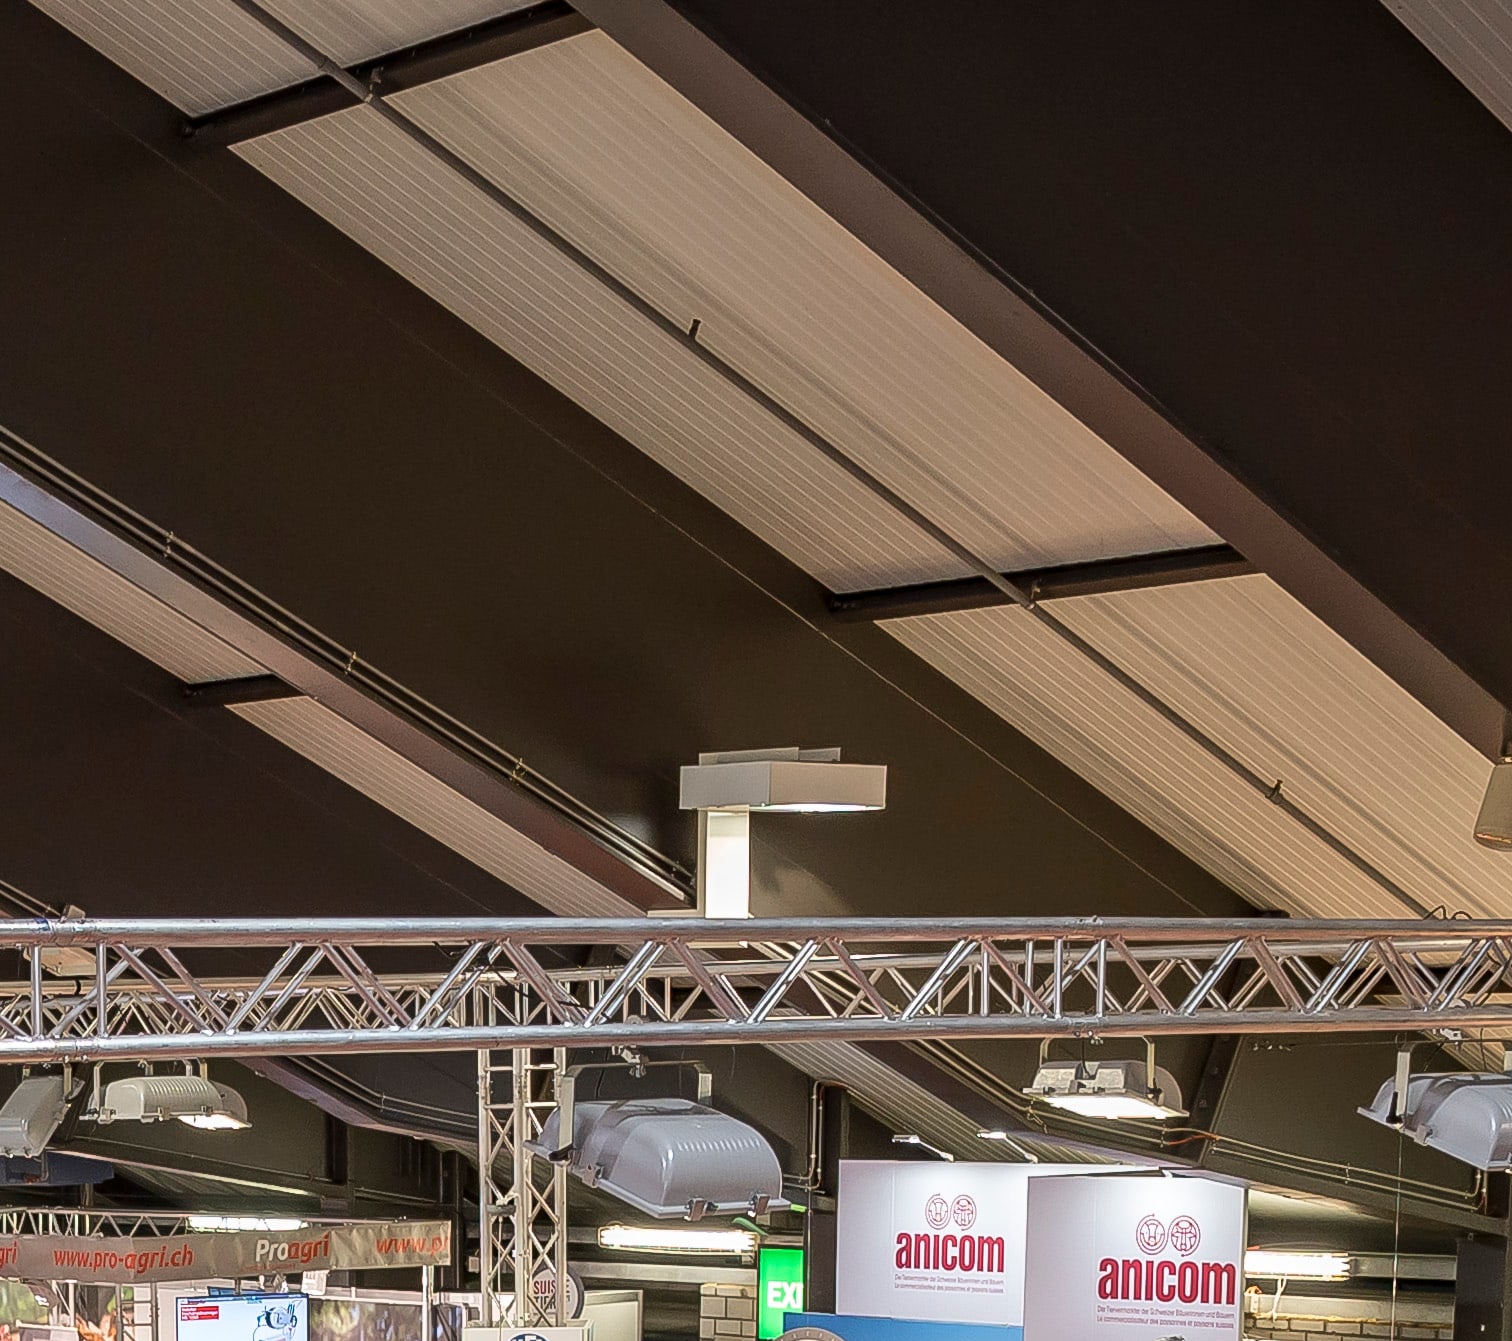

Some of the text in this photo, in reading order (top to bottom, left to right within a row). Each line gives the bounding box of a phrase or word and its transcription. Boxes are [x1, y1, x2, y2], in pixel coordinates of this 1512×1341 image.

[53, 1244, 194, 1274] www.pro-agri.ch
[255, 1234, 330, 1265] Proagri
[894, 1231, 1005, 1274] anicom
[1097, 1256, 1237, 1307] anicom
